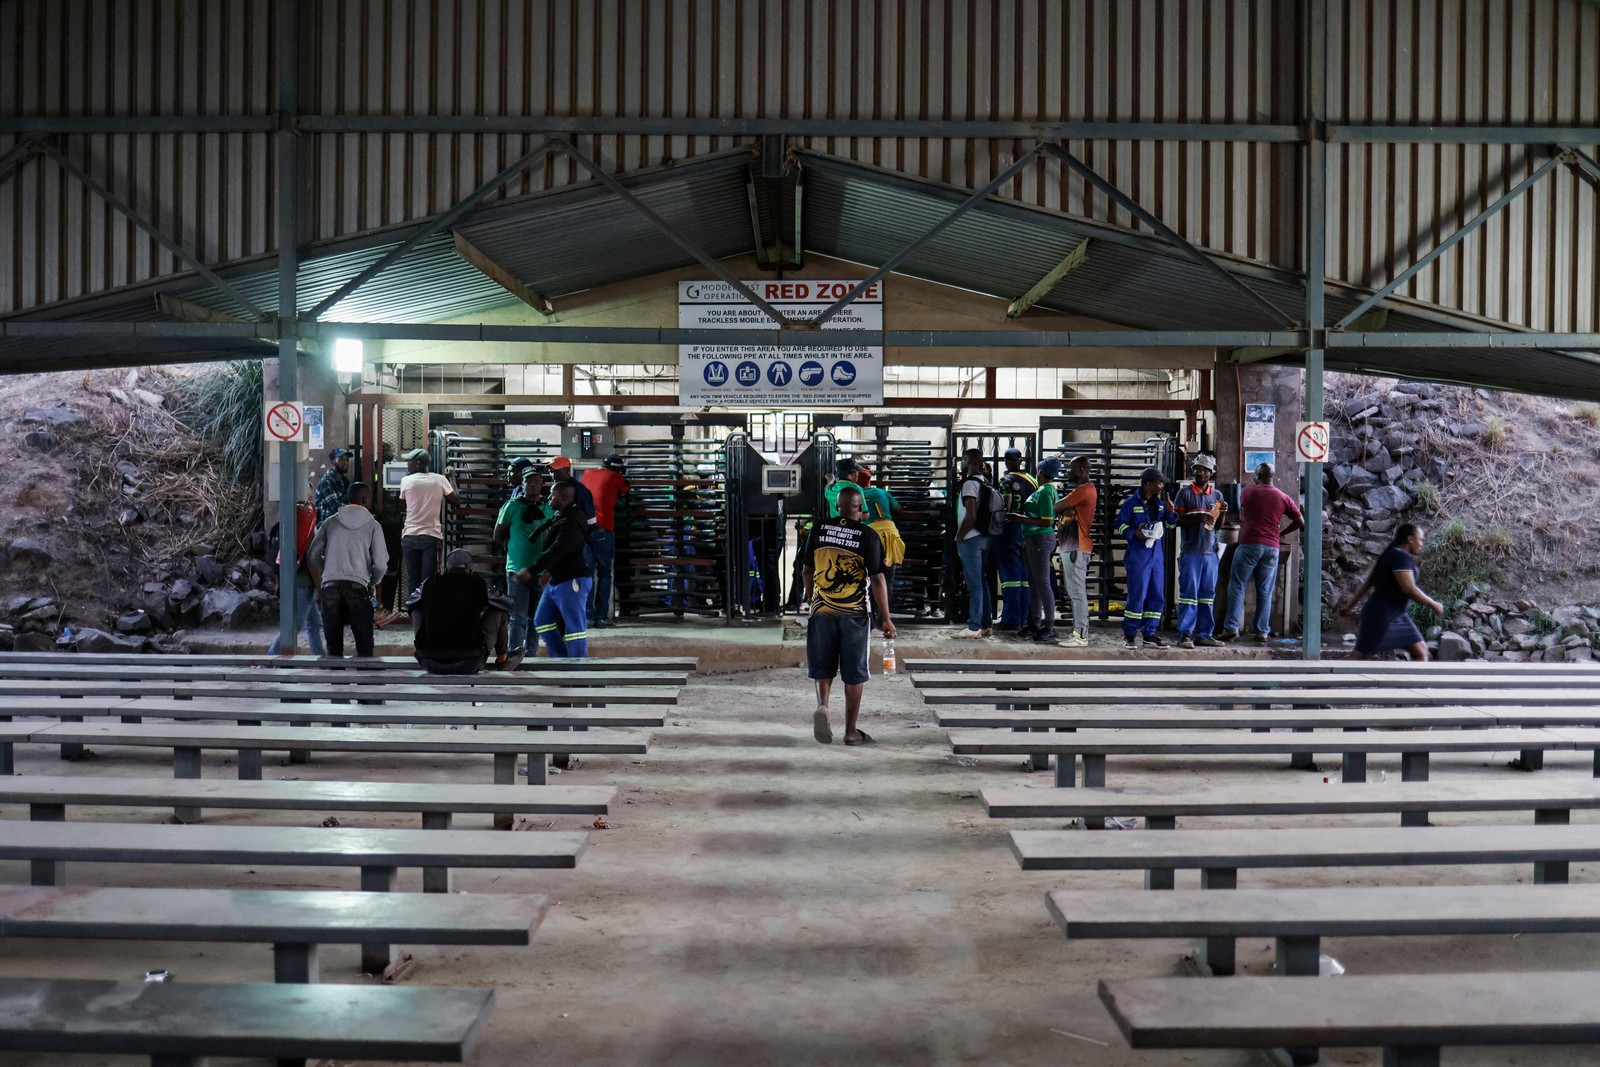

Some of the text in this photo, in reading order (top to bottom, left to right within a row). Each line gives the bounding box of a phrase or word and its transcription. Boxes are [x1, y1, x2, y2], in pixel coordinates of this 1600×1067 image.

[765, 283, 809, 300] RED
[825, 536, 845, 545] AUGUST
[845, 540, 859, 548] 2023
